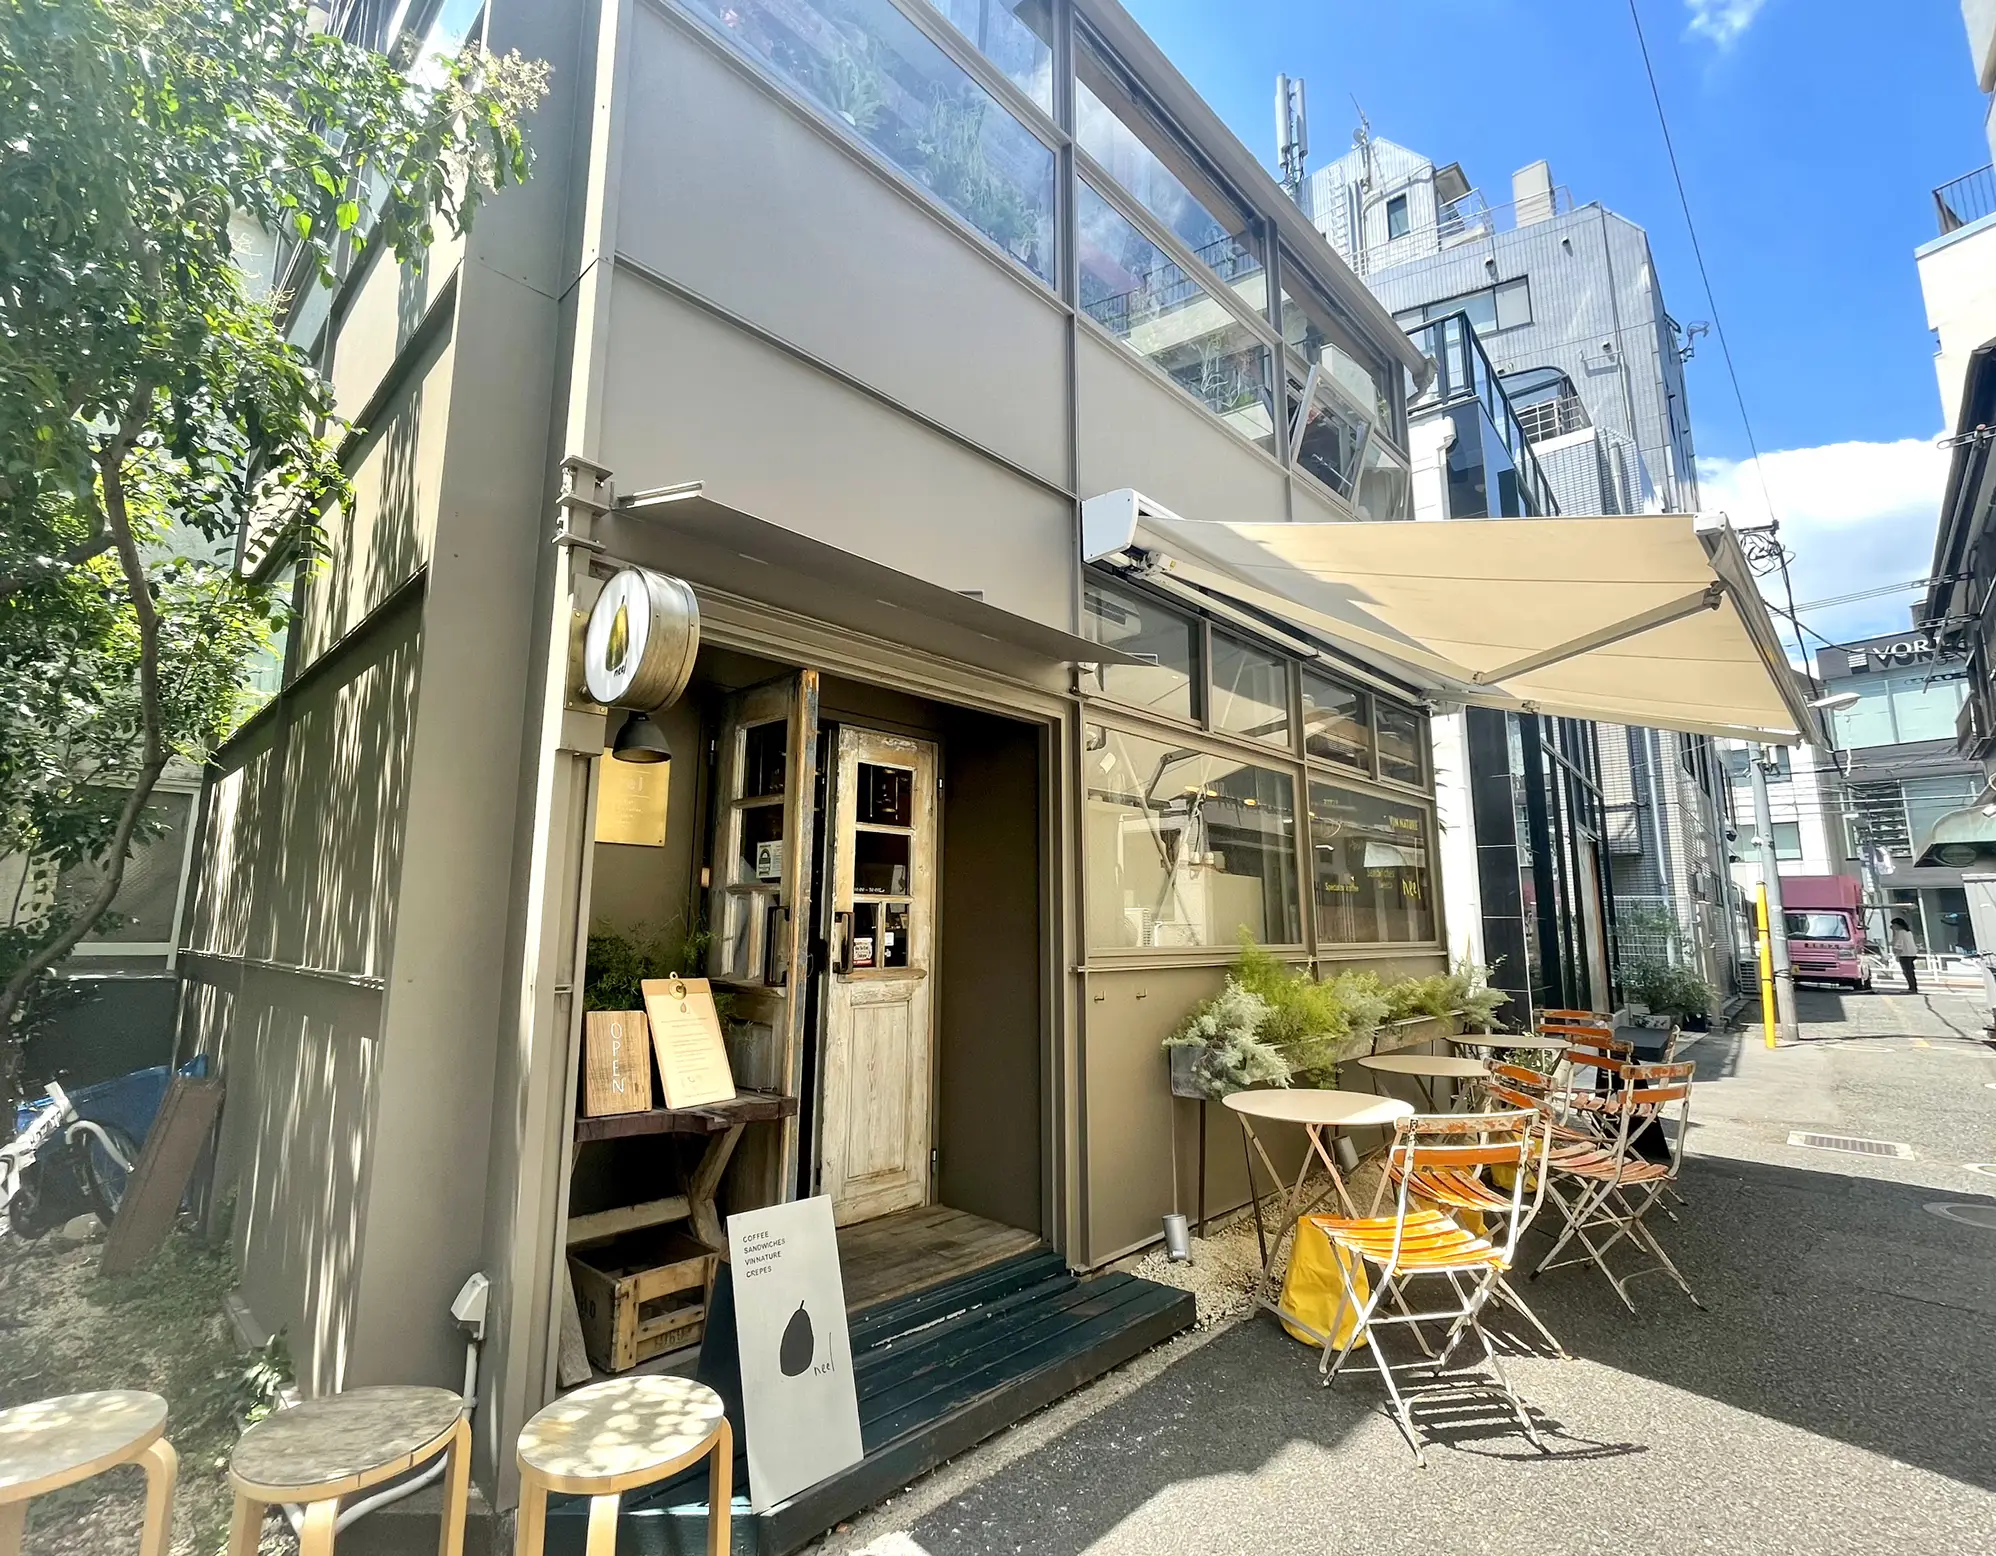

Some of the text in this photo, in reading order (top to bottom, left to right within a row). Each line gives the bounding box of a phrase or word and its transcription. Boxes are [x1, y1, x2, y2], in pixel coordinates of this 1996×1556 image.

[610, 1022, 625, 1093] OPEN
[742, 1230, 769, 1243] COFFEE
[743, 1238, 786, 1254] SANDWICHES
[745, 1265, 772, 1278] CREPES
[813, 1331, 835, 1377] neel
